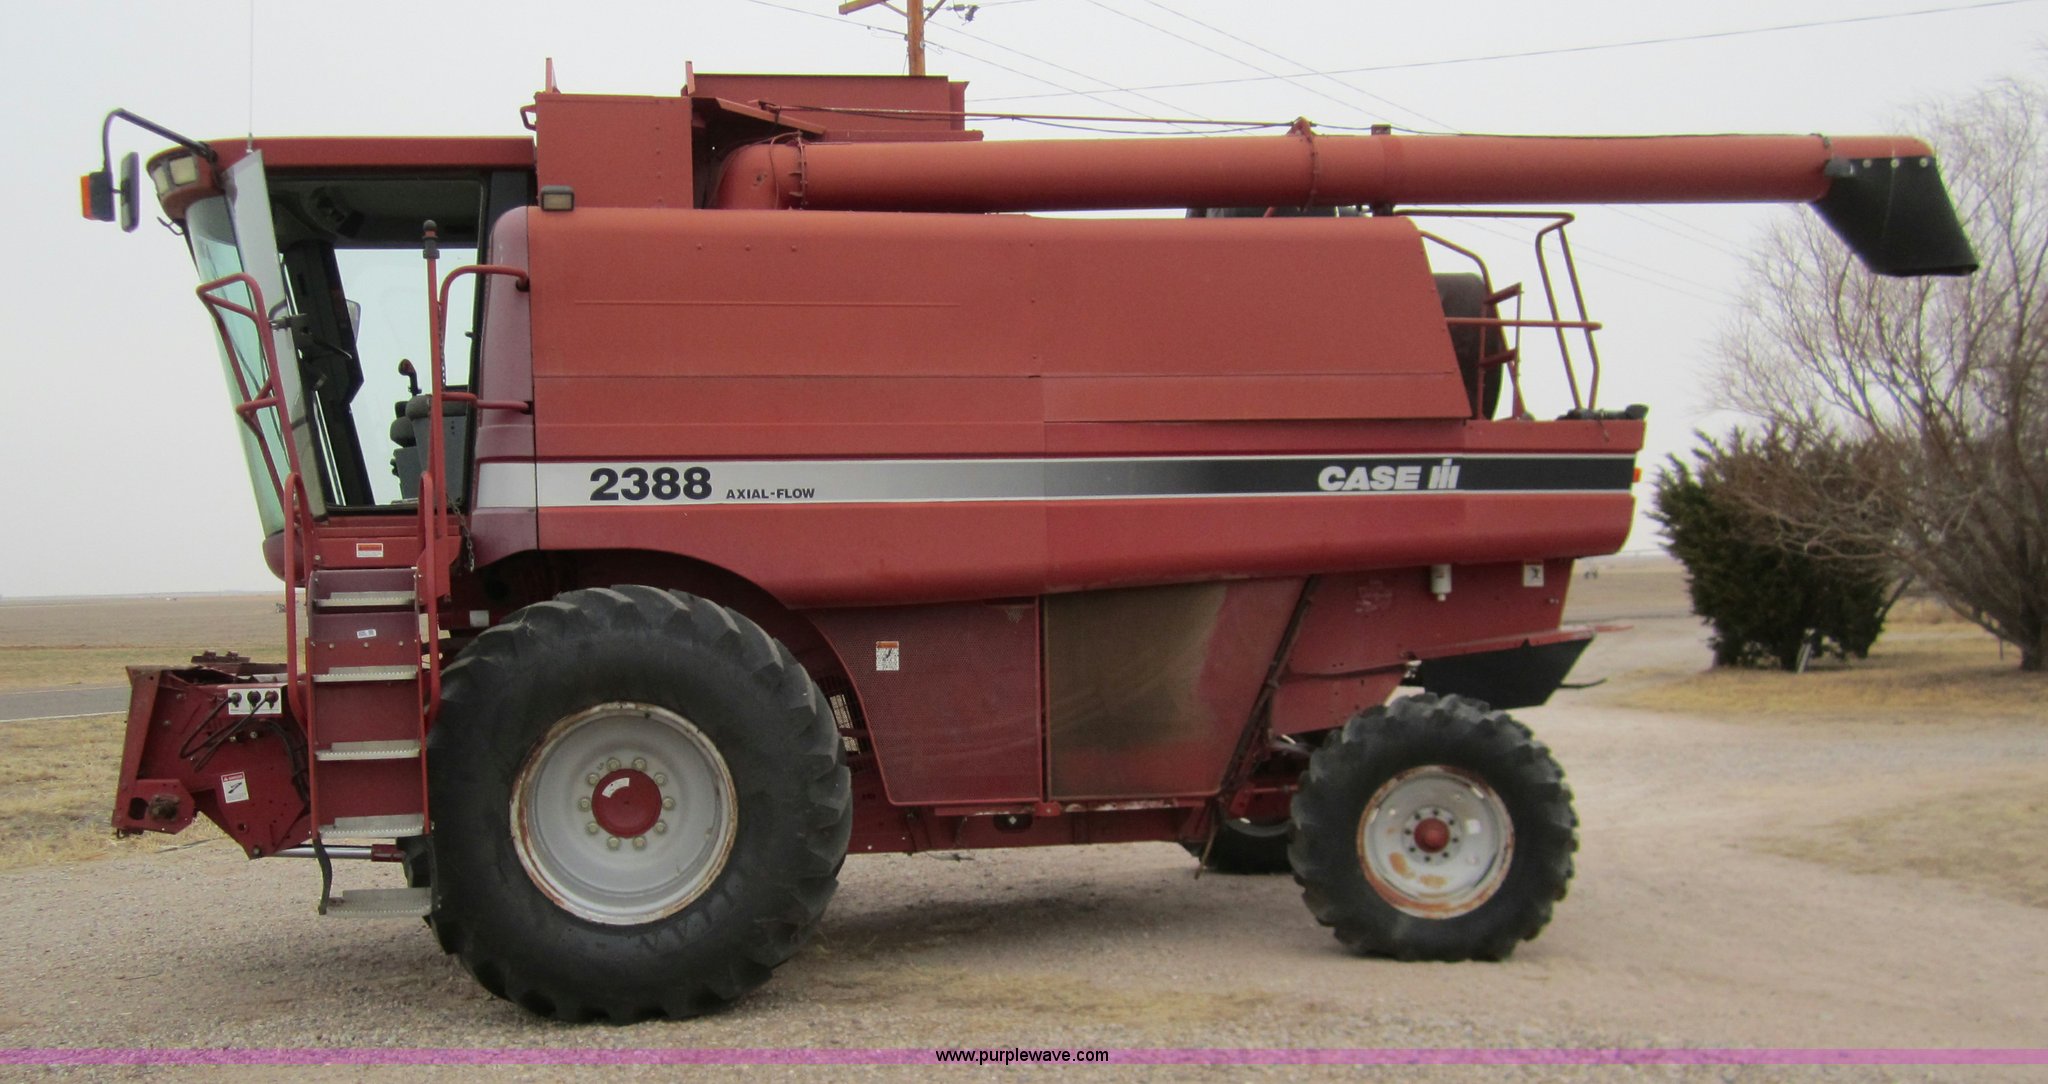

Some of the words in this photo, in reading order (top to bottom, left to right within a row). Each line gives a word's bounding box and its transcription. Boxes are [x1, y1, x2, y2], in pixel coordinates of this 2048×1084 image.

[590, 466, 712, 501] 2388
[726, 487, 815, 499] AXIAL-FLOW
[1318, 465, 1422, 491] CASE
